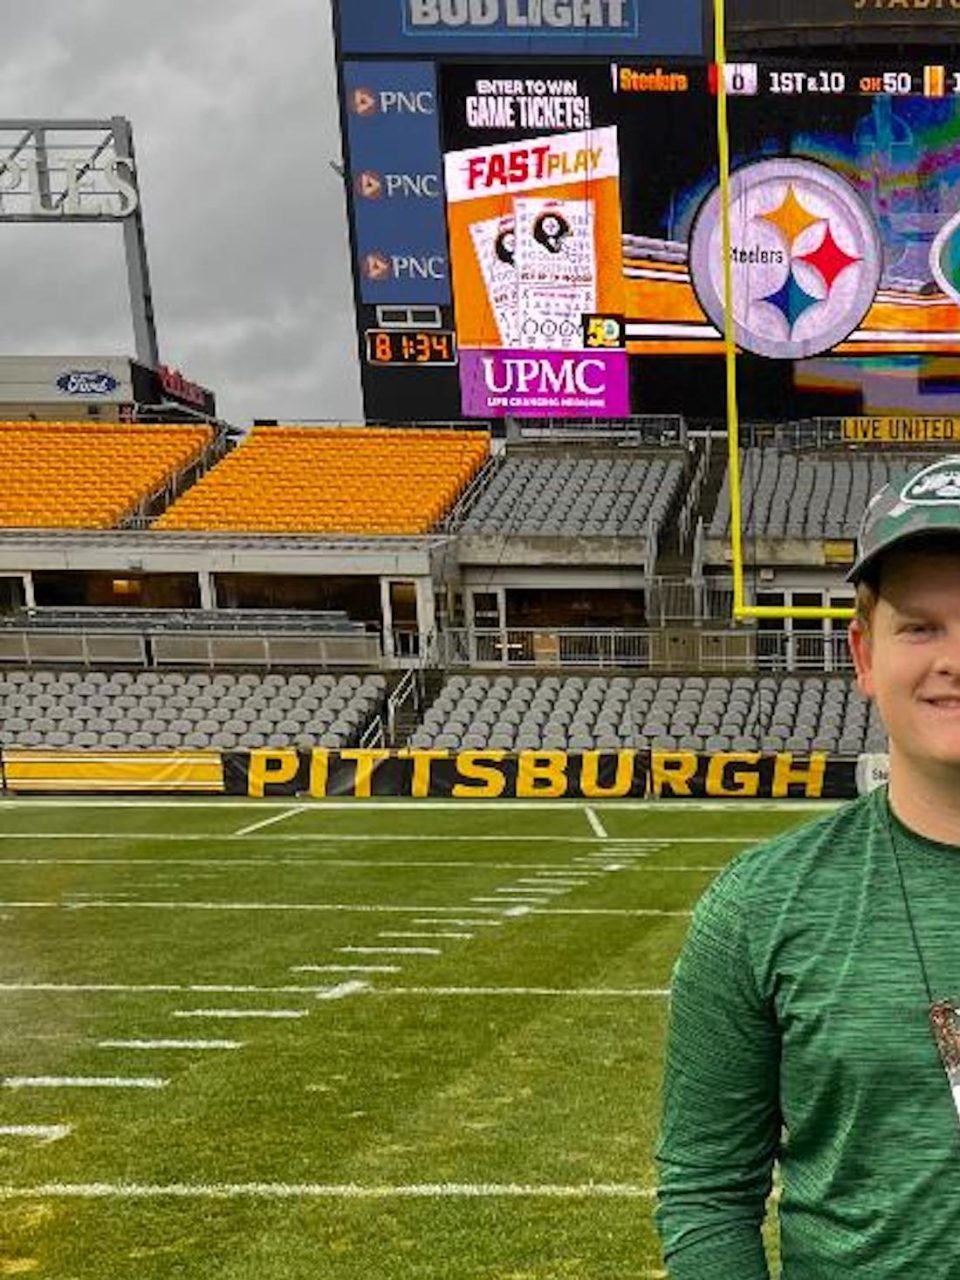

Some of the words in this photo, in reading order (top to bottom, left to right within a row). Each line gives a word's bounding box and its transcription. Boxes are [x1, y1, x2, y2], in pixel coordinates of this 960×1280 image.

[412, 0, 498, 25] BUD
[506, 0, 626, 27] LIGHT
[476, 80, 523, 95] ENTER
[525, 80, 546, 95] TO
[547, 80, 577, 96] WIN
[883, 72, 911, 93] 50
[379, 91, 434, 115] PNC
[466, 96, 515, 128] GAME
[517, 96, 591, 128] TICKETS!
[385, 174, 439, 198] PNC
[391, 254, 445, 279] PNC
[729, 245, 783, 264] teelers
[68, 374, 109, 393] Ford
[482, 358, 606, 394] UPMC
[844, 419, 882, 439] LIVE
[888, 419, 954, 440] UNITED
[247, 748, 827, 799] PITTSBURGH
